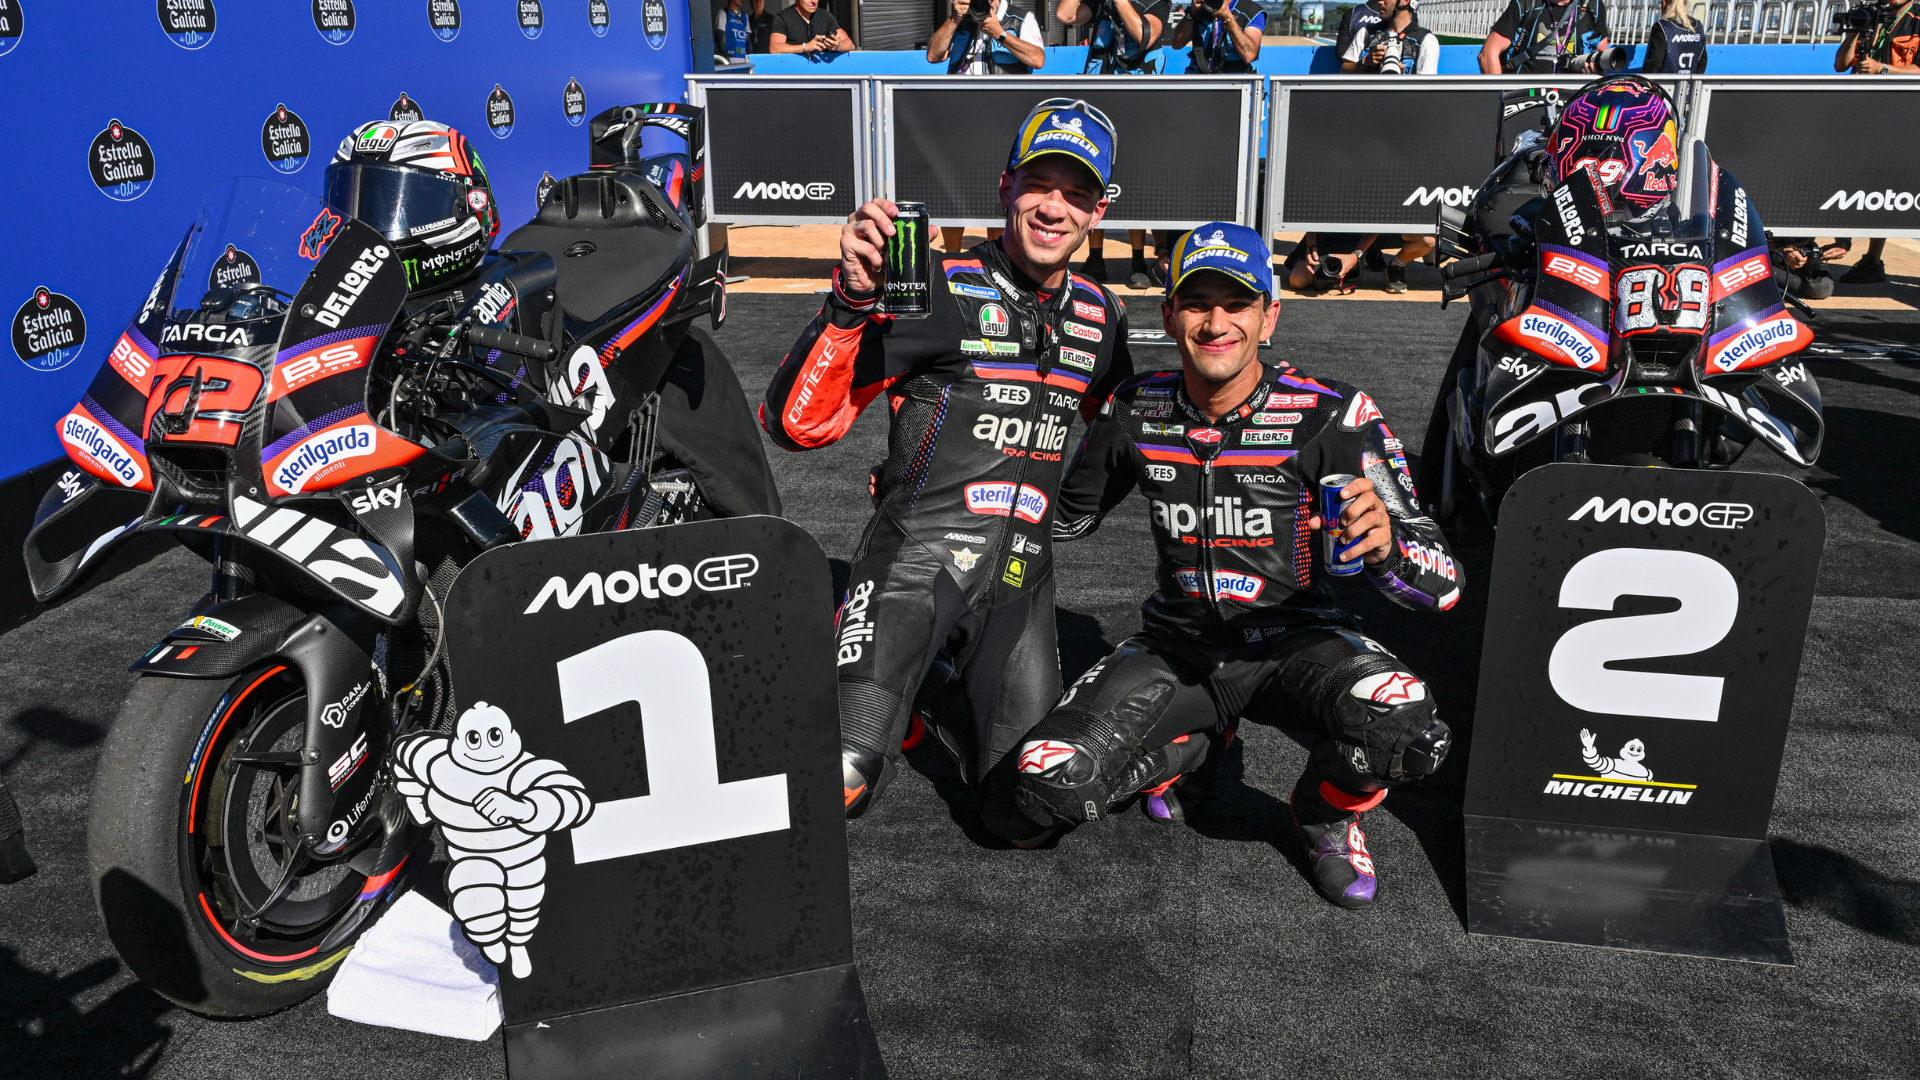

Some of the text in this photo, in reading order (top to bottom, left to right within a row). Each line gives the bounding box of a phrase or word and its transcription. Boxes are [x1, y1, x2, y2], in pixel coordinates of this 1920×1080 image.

[520, 2, 539, 13] Estrella
[645, 3, 663, 17] Estrella
[170, 11, 206, 29] Galicia
[321, 12, 348, 27] Galicia
[434, 13, 455, 26] Galicia
[522, 14, 539, 26] Galicia
[647, 18, 664, 32] Galicia
[490, 100, 509, 113] Estrella
[492, 112, 511, 125] Galicia
[268, 123, 302, 141] Estrella
[1581, 132, 1625, 142] DAN JOHN
[98, 141, 143, 163] Estrella
[272, 139, 303, 157] Galicia
[361, 138, 390, 151] agv
[1034, 132, 1100, 158] MICHELIN
[102, 161, 144, 182] Galicia
[1643, 171, 1666, 191] Red
[733, 180, 835, 200] MotoGP
[1402, 186, 1478, 207] Moto
[1819, 189, 1920, 211] Moto
[1552, 184, 1586, 246] DELLORTO
[1730, 187, 1749, 248] DELLORTO
[422, 239, 481, 270] MONSTER
[1183, 249, 1248, 270] MICHELIN
[1620, 243, 1704, 259] TARGA
[217, 261, 253, 285] Estrella
[434, 255, 477, 277] ENERGY
[1548, 256, 1602, 286] BS
[1718, 259, 1767, 288] BS
[315, 245, 390, 329] DELLORTO
[885, 281, 927, 291] ONSTER
[964, 288, 996, 296] MICHELIN
[991, 270, 1020, 301] aprilia
[1725, 270, 1770, 292] BATTERY
[472, 282, 512, 325] aprilia
[1074, 302, 1103, 318] BS
[1615, 267, 1711, 332] 89
[23, 307, 73, 336] Estrella
[985, 322, 1005, 335] agv
[27, 325, 74, 354] Galicia
[160, 323, 250, 347] TARGA
[1072, 325, 1100, 341] Castrol
[1523, 317, 1594, 364] sterilgarda
[1719, 320, 1793, 368] sterilgarda
[962, 341, 1018, 352] Green Power
[1540, 340, 1566, 358] alimenti
[1750, 345, 1777, 362] alimenti
[113, 338, 151, 378] BS
[281, 344, 359, 385] BS
[1062, 350, 1093, 367] DELLORTO
[1498, 356, 1541, 381] sky
[287, 359, 362, 389] BATTERY
[788, 340, 838, 425] DAINESE
[1775, 362, 1807, 387] sky
[999, 387, 1027, 402] FES
[1269, 394, 1315, 405] BS
[1263, 414, 1300, 423] Castrol
[972, 413, 1069, 451] aprilia
[1245, 432, 1289, 442] DELLORTO
[65, 418, 136, 482] sterilgarda
[78, 450, 104, 472] alimenti
[279, 427, 370, 489] sterilgarda
[1002, 447, 1062, 462] RACING
[313, 460, 346, 482] alimenti
[1153, 467, 1173, 479] FES
[1235, 474, 1286, 484] TARGA
[57, 470, 86, 504] sky
[351, 482, 403, 516] sky
[1152, 496, 1273, 538] aprilia
[1567, 496, 1754, 529] MotoGP
[943, 532, 987, 544] MotoGP
[1182, 535, 1275, 548] RACING
[1407, 540, 1458, 582] aprilia
[523, 553, 759, 615] MotoGP
[202, 618, 235, 635] Power
[837, 579, 875, 667] aprilia
[1548, 547, 1739, 722] 2
[342, 682, 362, 707] PAN
[193, 697, 227, 762] MICHELIN
[328, 731, 368, 784] SC
[556, 629, 791, 865] 1
[1543, 780, 1693, 805] MICHELIN
